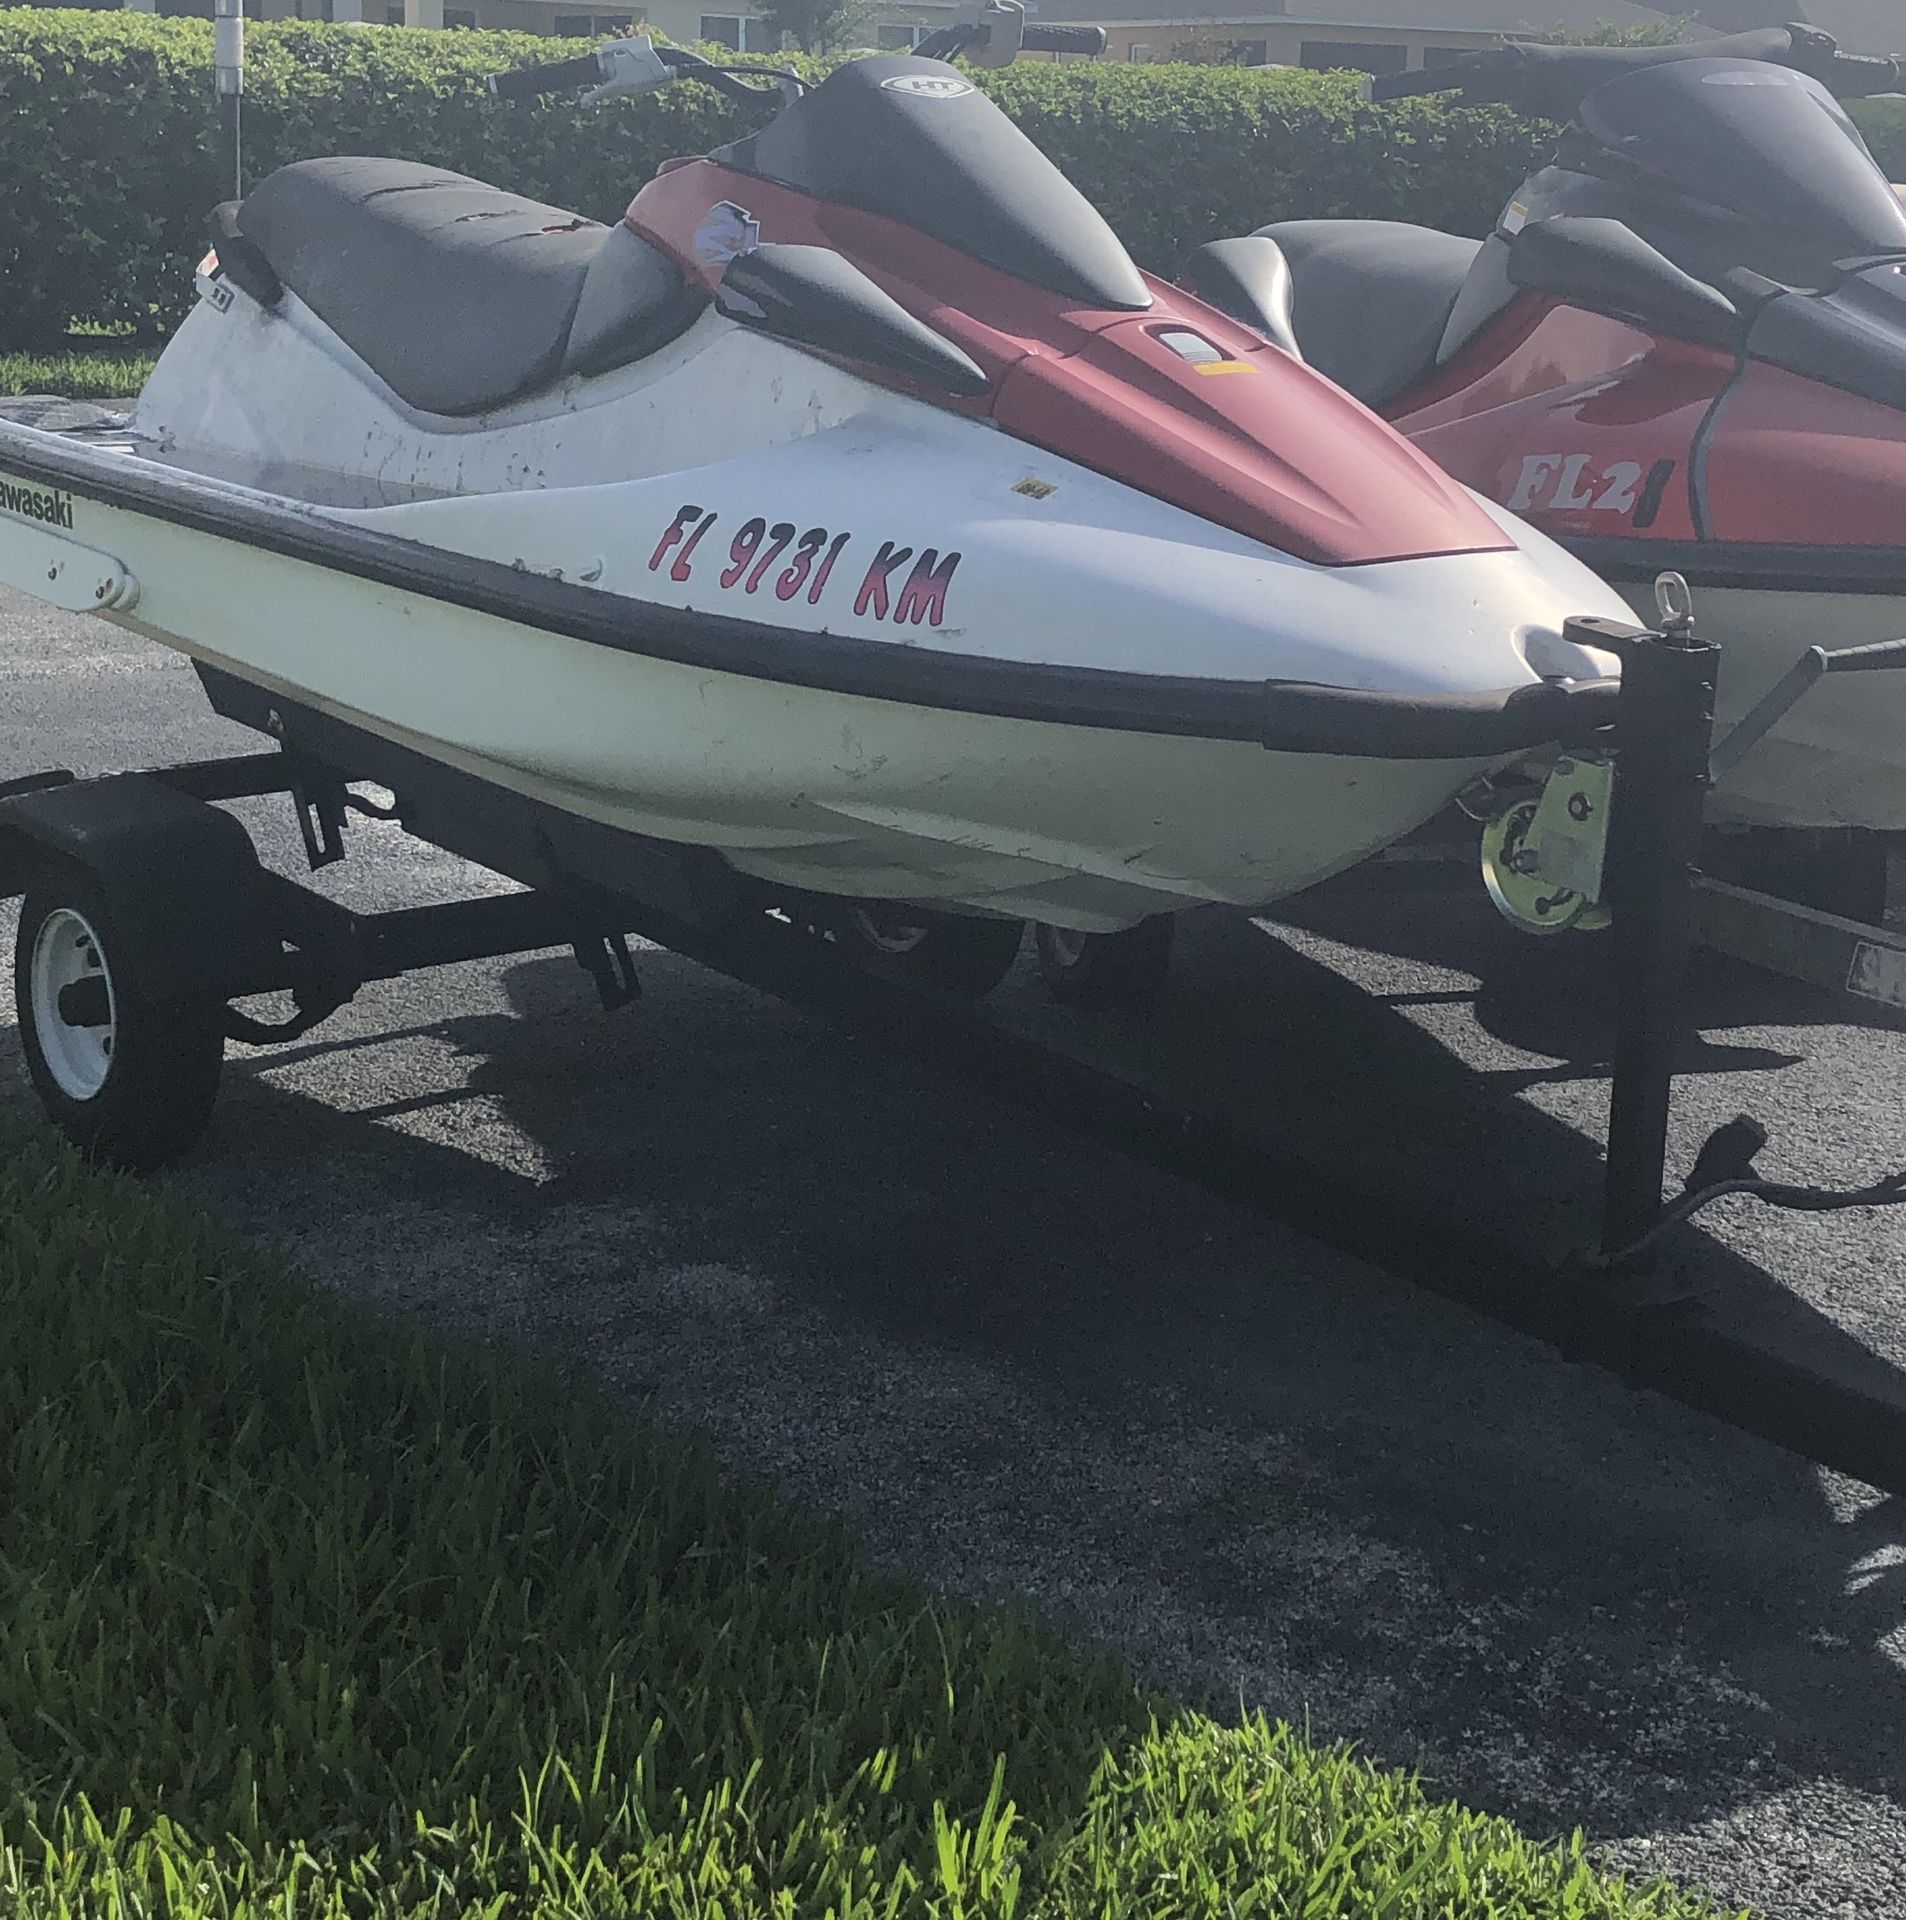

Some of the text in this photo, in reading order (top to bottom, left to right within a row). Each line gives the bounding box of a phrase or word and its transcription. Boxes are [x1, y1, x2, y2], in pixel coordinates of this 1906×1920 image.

[648, 504, 962, 627] FL 9731 KM
